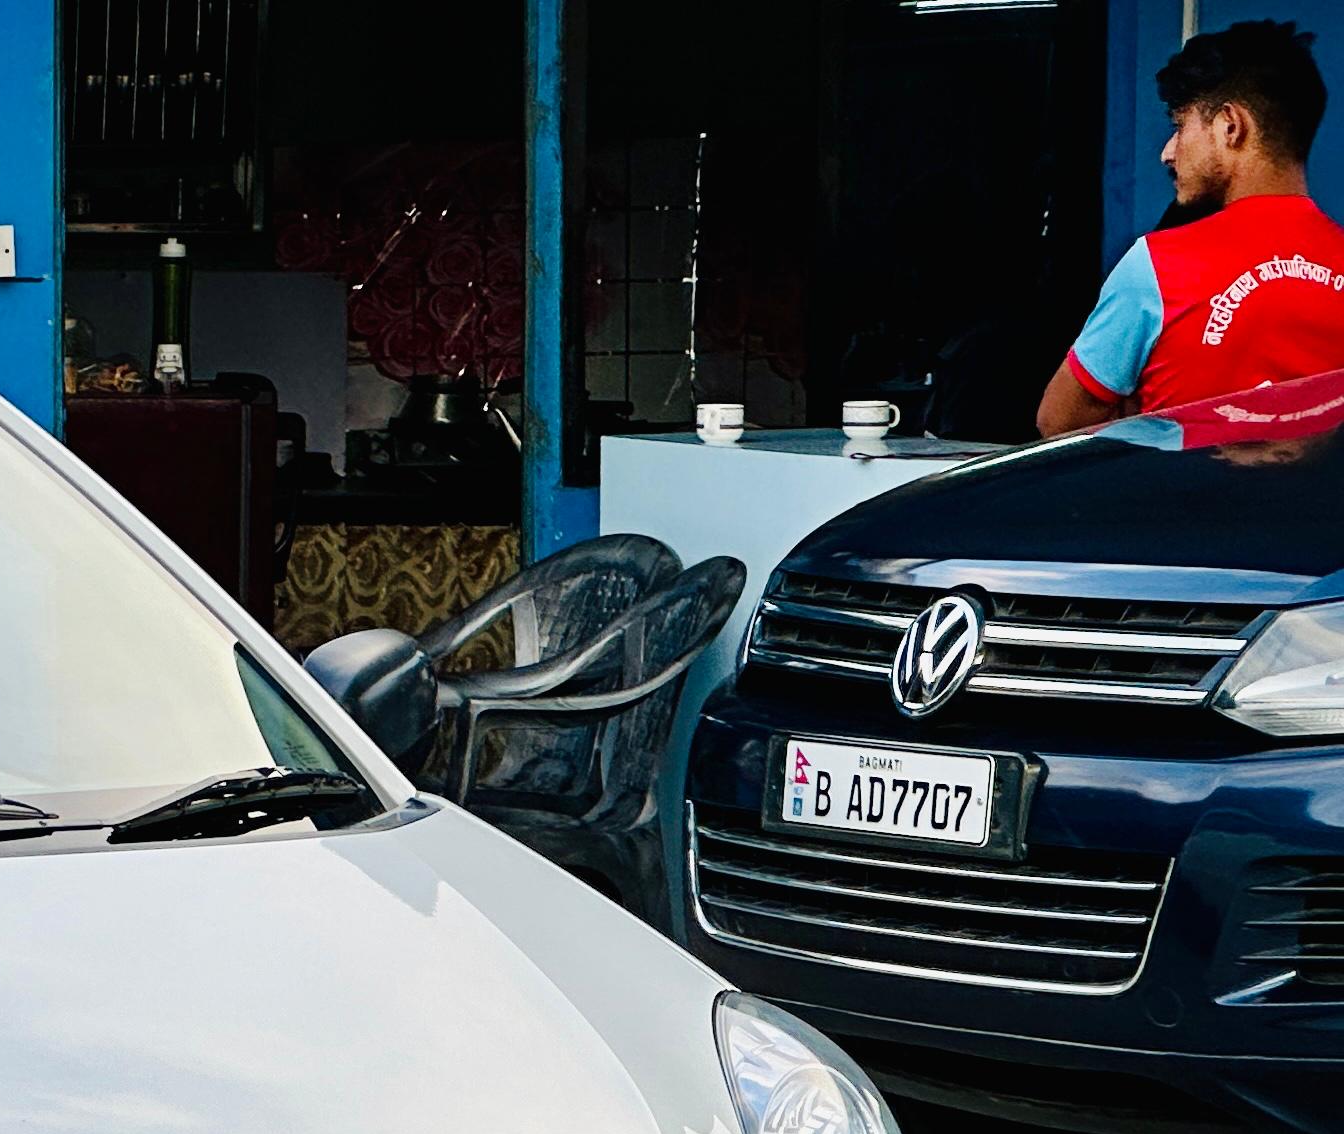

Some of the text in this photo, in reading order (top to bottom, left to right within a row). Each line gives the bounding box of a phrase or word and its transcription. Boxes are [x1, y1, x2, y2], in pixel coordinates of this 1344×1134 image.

[858, 755, 903, 772] BAGMATI
[814, 771, 973, 832] B AD7707
